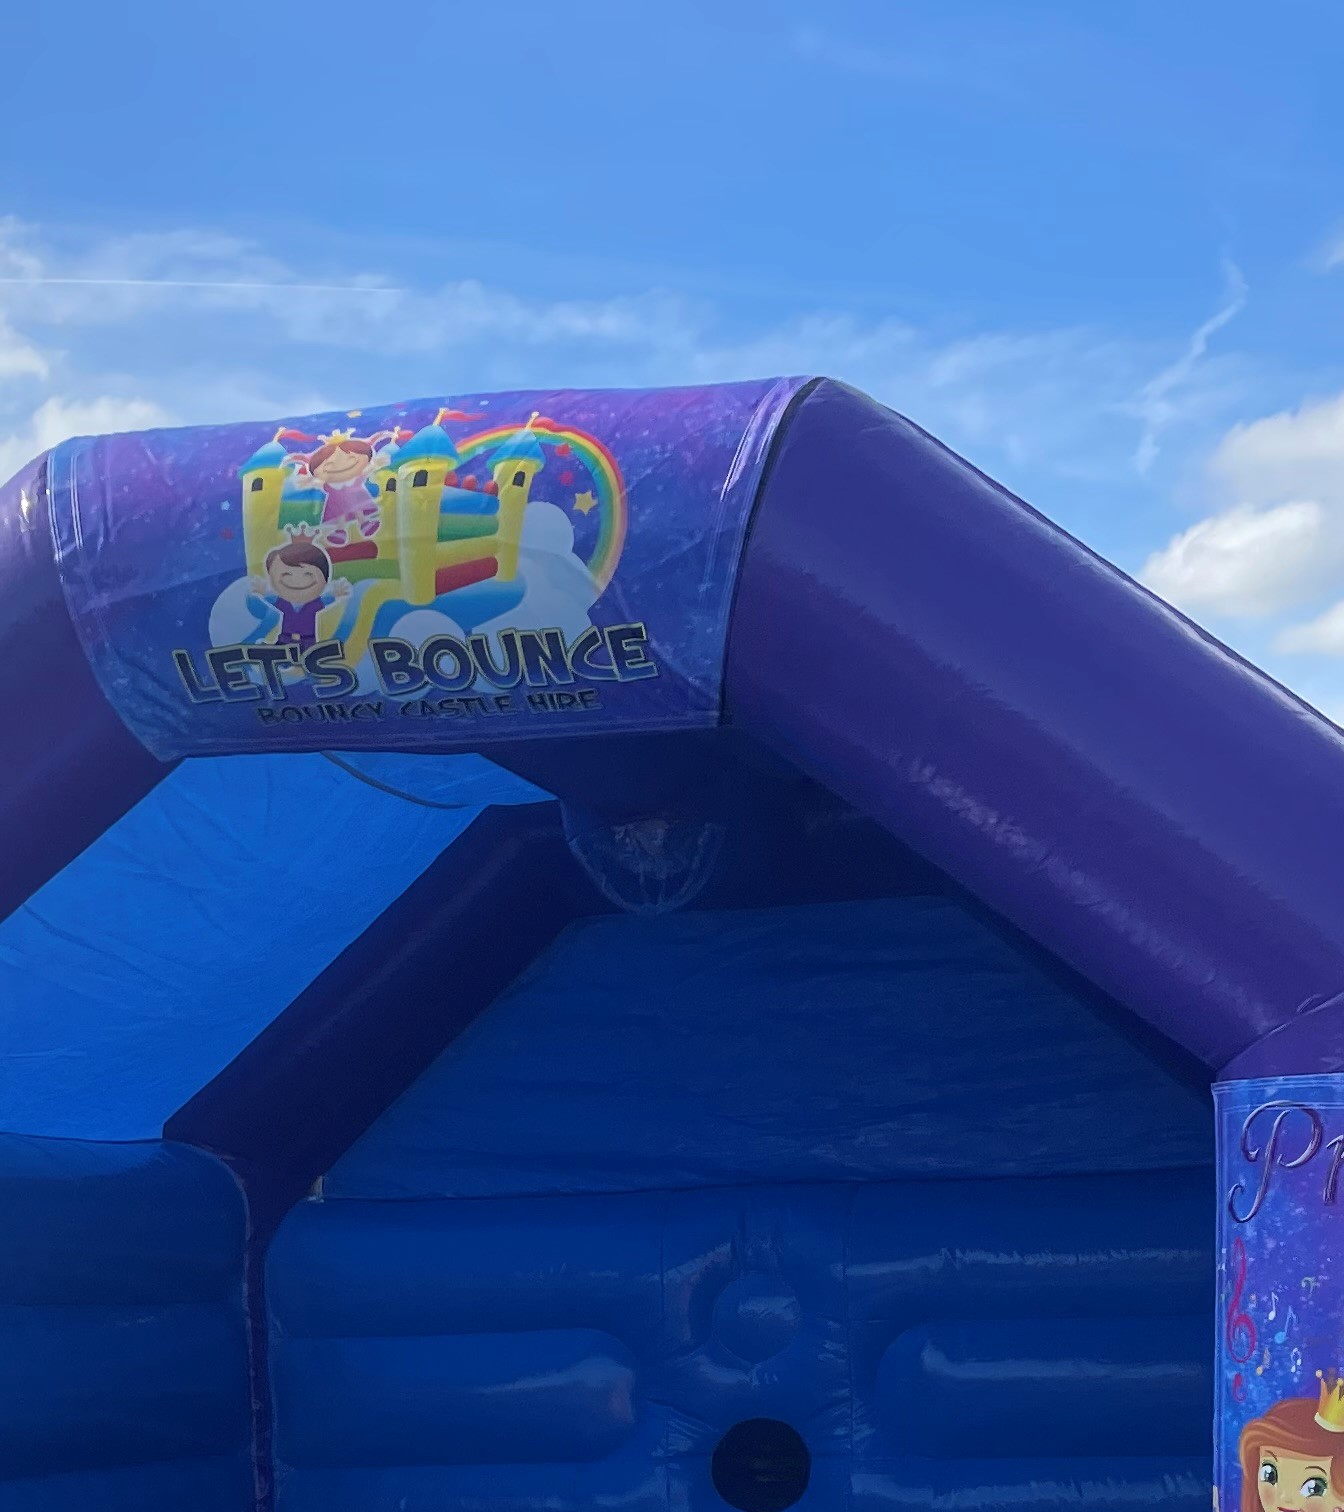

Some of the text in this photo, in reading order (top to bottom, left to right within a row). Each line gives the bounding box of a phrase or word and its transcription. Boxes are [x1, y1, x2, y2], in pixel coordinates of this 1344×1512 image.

[170, 621, 659, 703] LET'S BOUNCE
[256, 688, 603, 727] BOUNCY CASTLE HIRE
